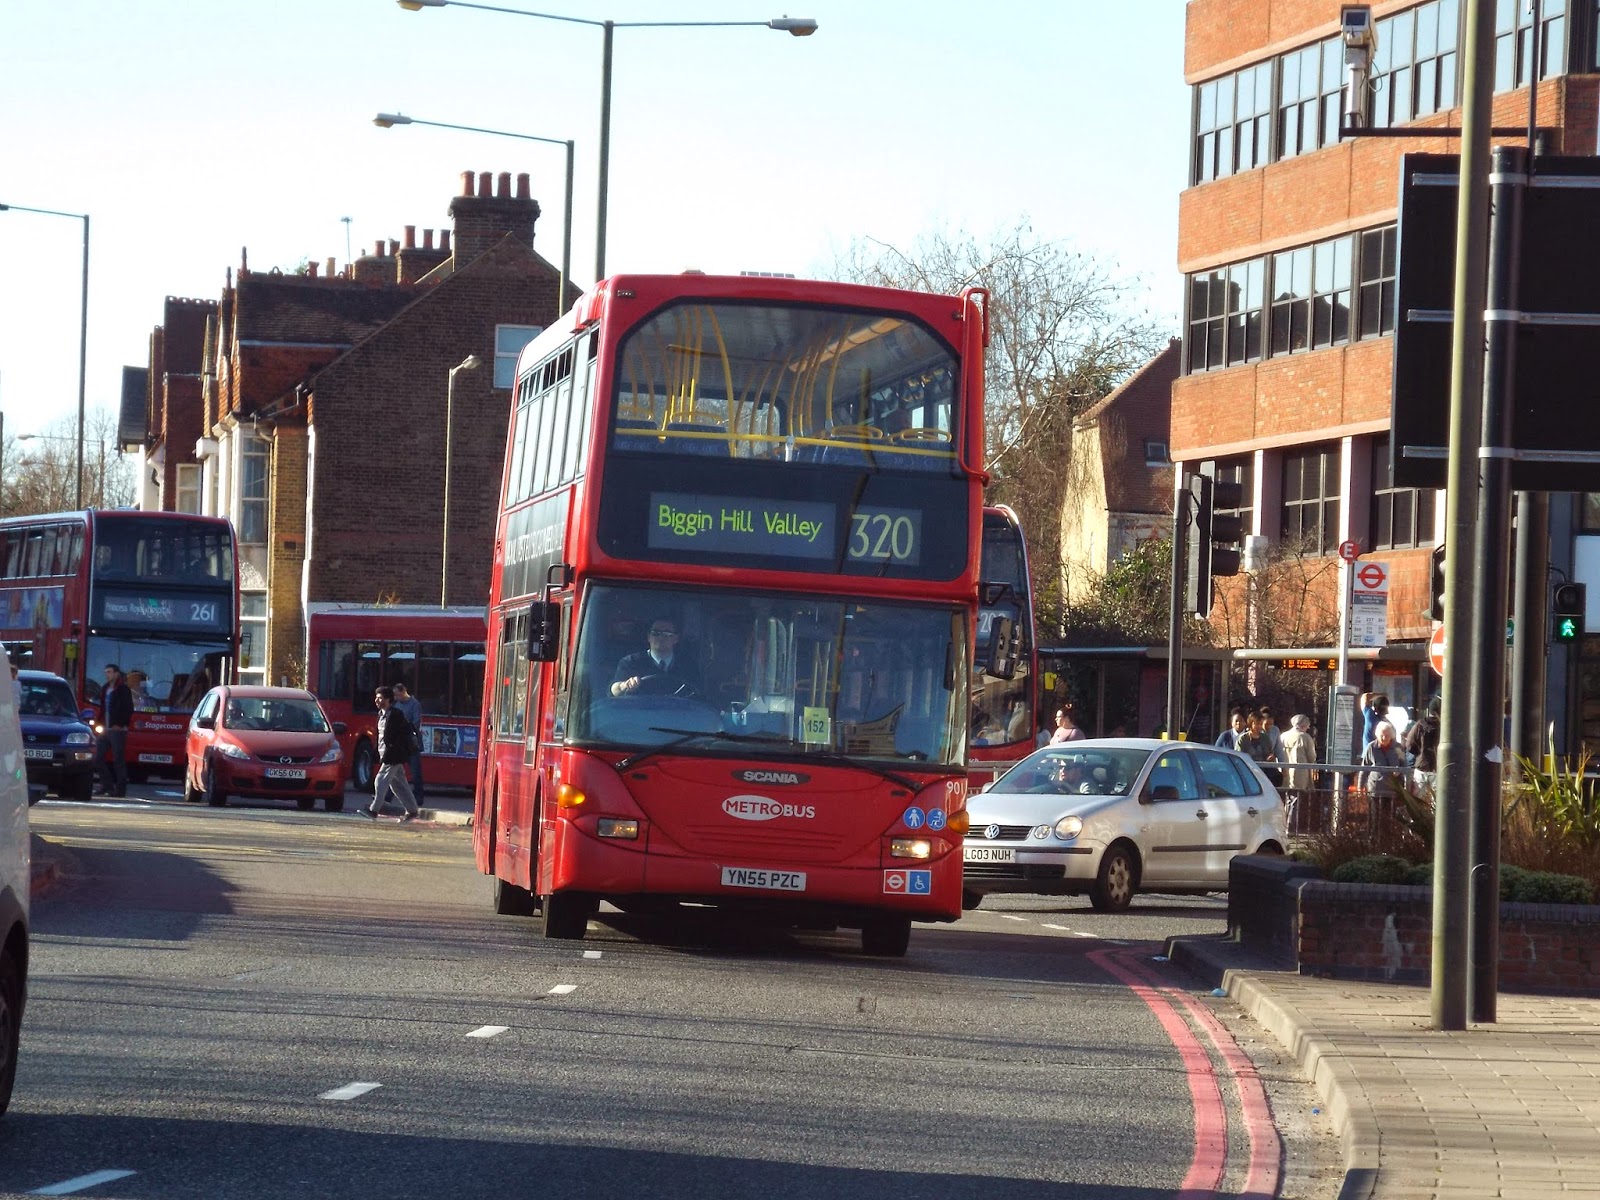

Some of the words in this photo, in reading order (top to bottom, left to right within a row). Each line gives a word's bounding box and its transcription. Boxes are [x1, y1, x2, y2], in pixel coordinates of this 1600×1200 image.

[657, 503, 713, 536] Biggin
[720, 508, 754, 533] Hill
[763, 511, 823, 543] Valley
[849, 513, 914, 560] 320
[1343, 543, 1354, 558] E
[190, 603, 215, 621] 261
[979, 612, 1007, 633] 20
[144, 721, 183, 731] Stagecoach
[806, 719, 824, 733] 152
[743, 770, 799, 784] SCANIA
[725, 799, 816, 819] METROBUS
[964, 849, 989, 861] LG03
[991, 849, 1011, 861] NUH
[728, 869, 767, 886] YN55
[770, 872, 800, 888] PZC
